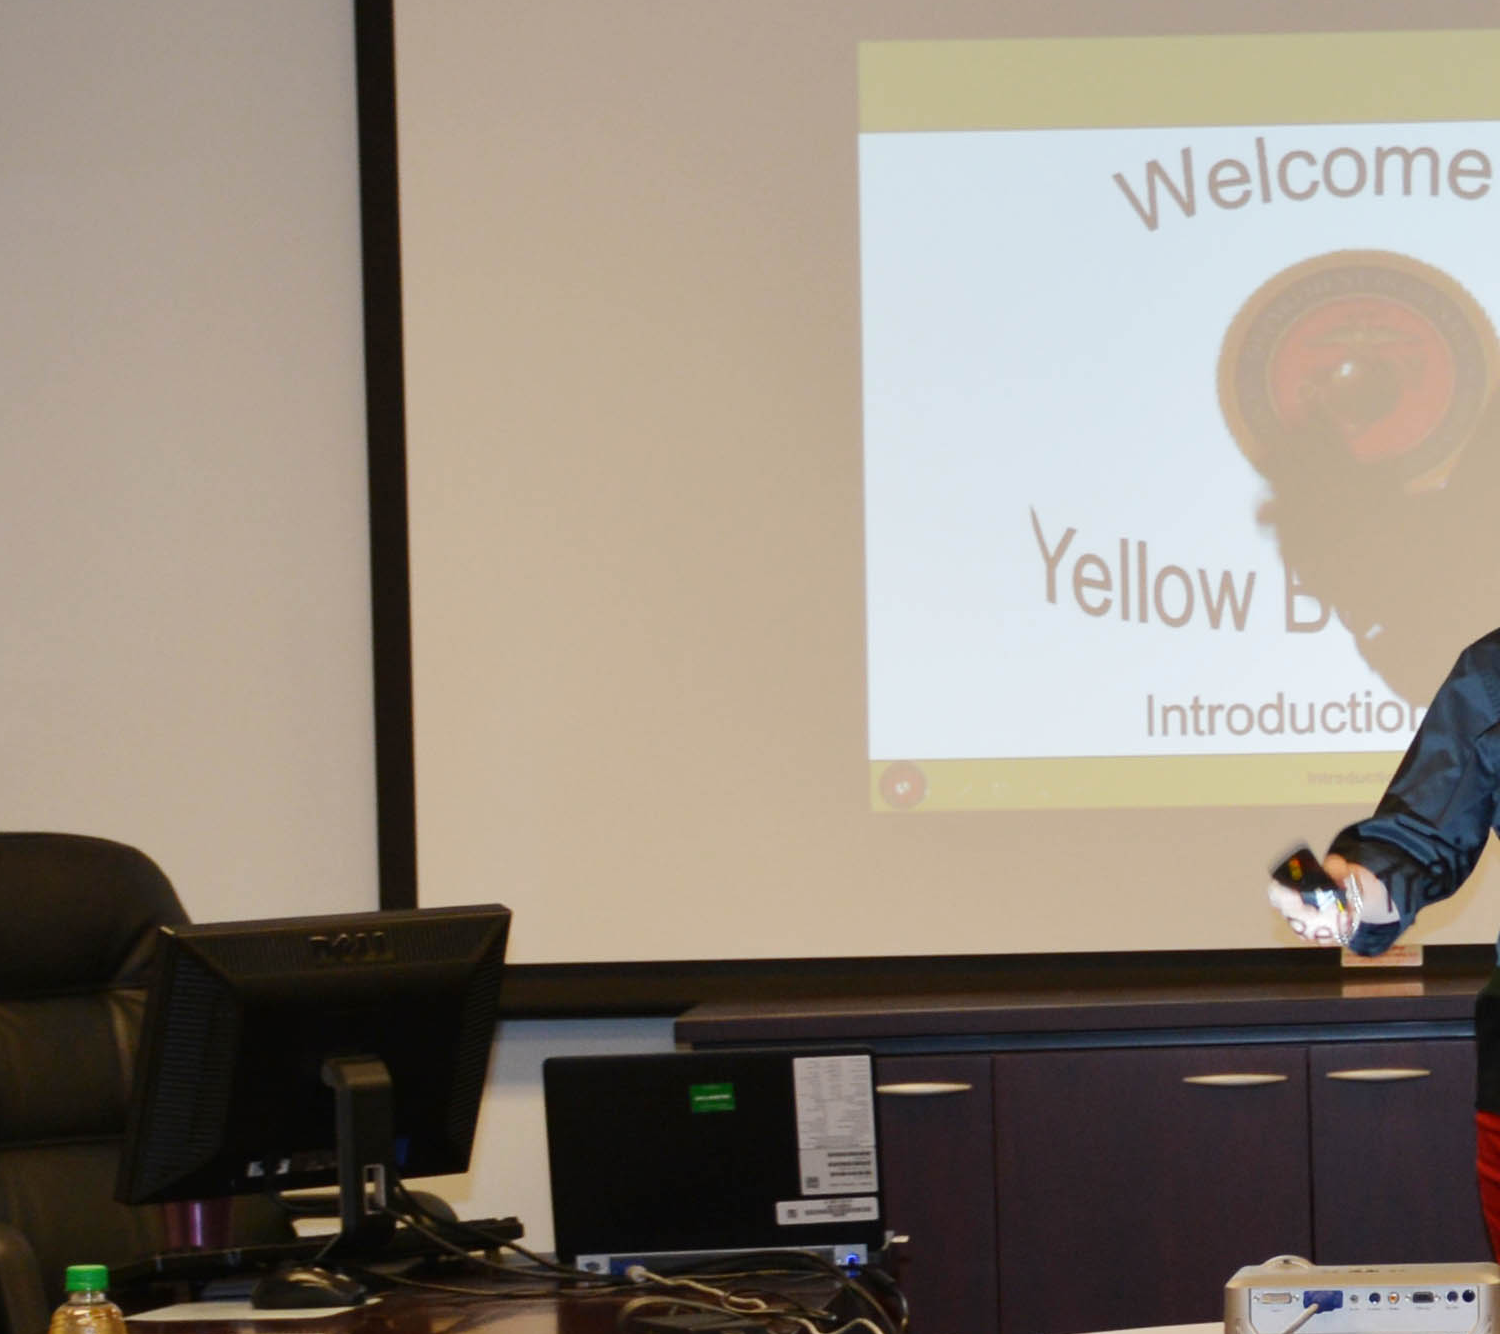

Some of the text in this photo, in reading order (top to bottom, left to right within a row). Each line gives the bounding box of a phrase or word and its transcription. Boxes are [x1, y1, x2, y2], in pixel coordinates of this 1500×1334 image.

[1112, 136, 1494, 232] Welcome
[1029, 504, 1256, 634] Yellow
[1146, 690, 1430, 738] Introduction
